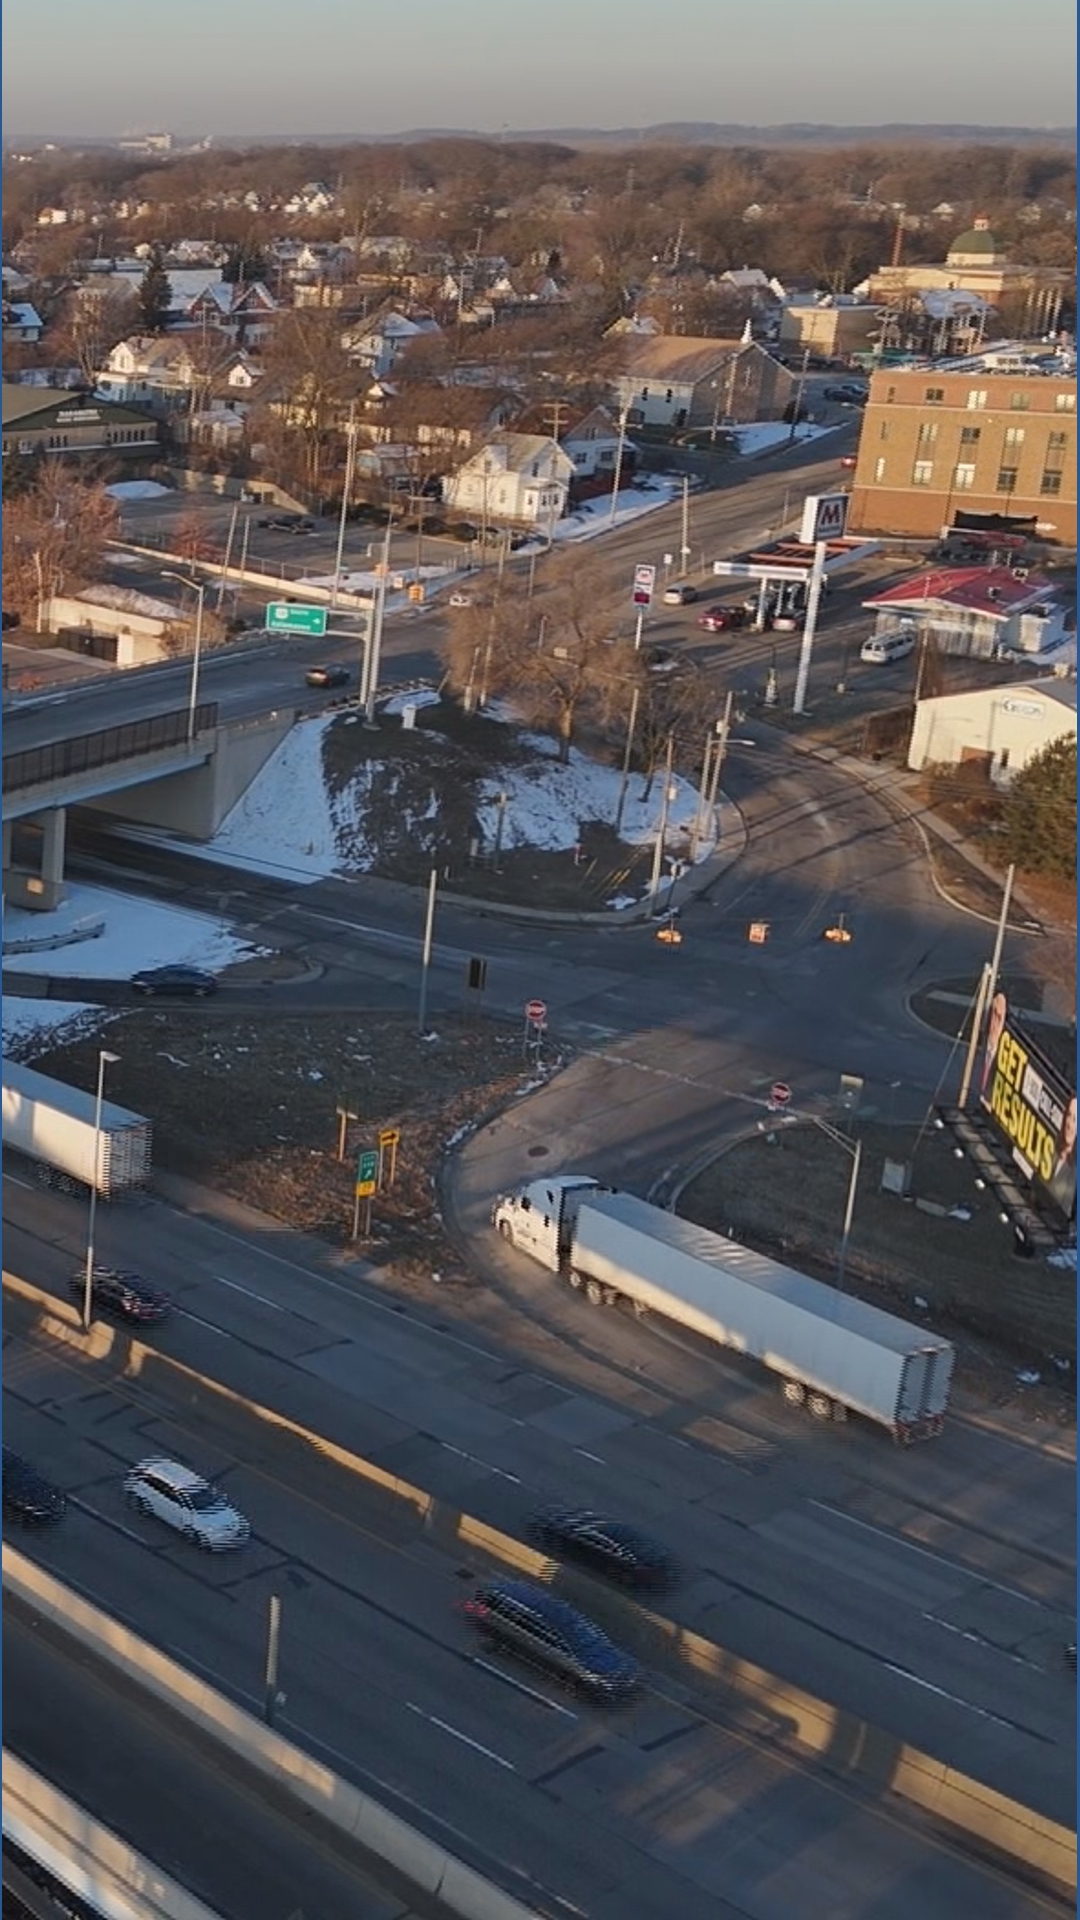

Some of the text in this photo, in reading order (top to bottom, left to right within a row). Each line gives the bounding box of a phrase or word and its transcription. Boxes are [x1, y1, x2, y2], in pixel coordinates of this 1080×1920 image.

[820, 504, 840, 525] M
[997, 1030, 1028, 1095] GET
[992, 1071, 1055, 1181] RESULTS
